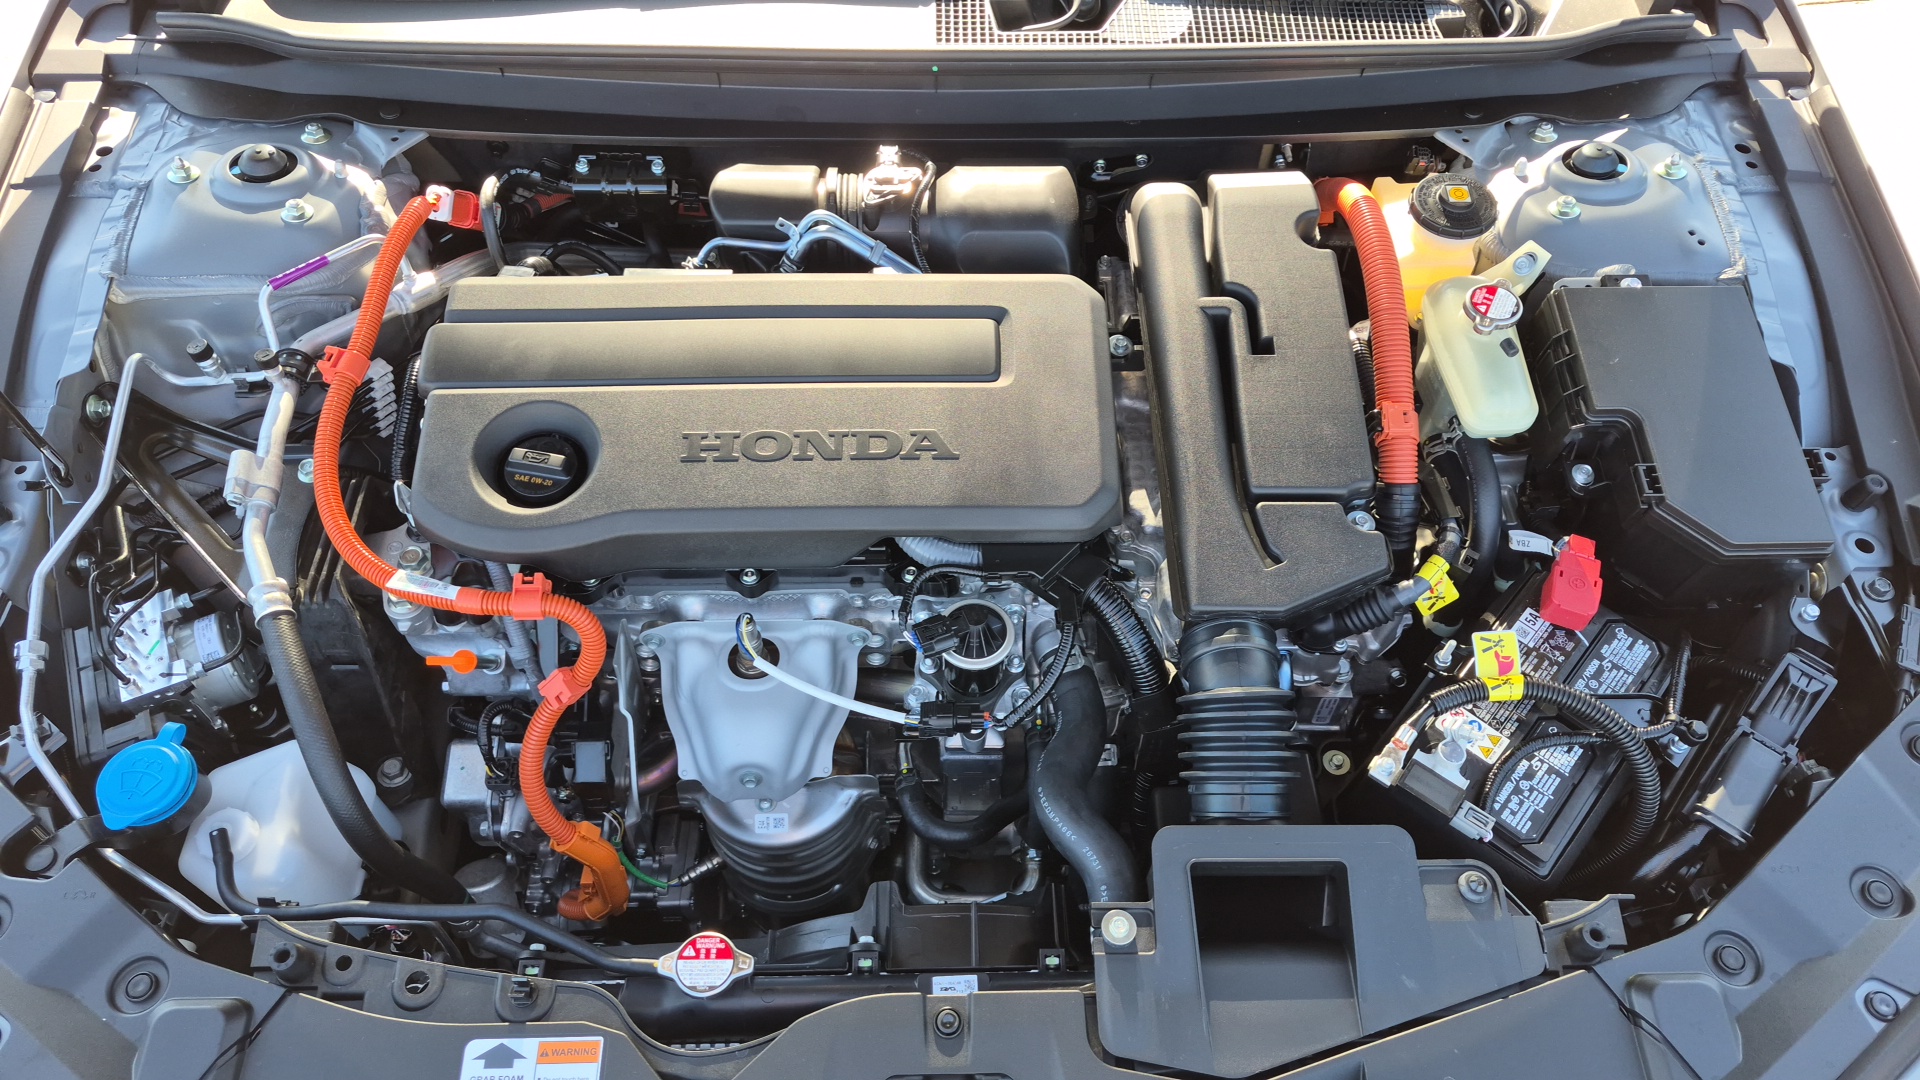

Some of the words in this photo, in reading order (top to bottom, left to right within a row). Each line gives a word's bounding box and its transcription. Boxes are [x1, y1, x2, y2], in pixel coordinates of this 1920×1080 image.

[680, 429, 960, 462] HONDA
[514, 474, 529, 482] SAE
[530, 476, 553, 486] 0W-20
[1516, 539, 1530, 547] ZBA
[1526, 611, 1541, 627] 5A
[551, 1047, 597, 1057] WARNING
